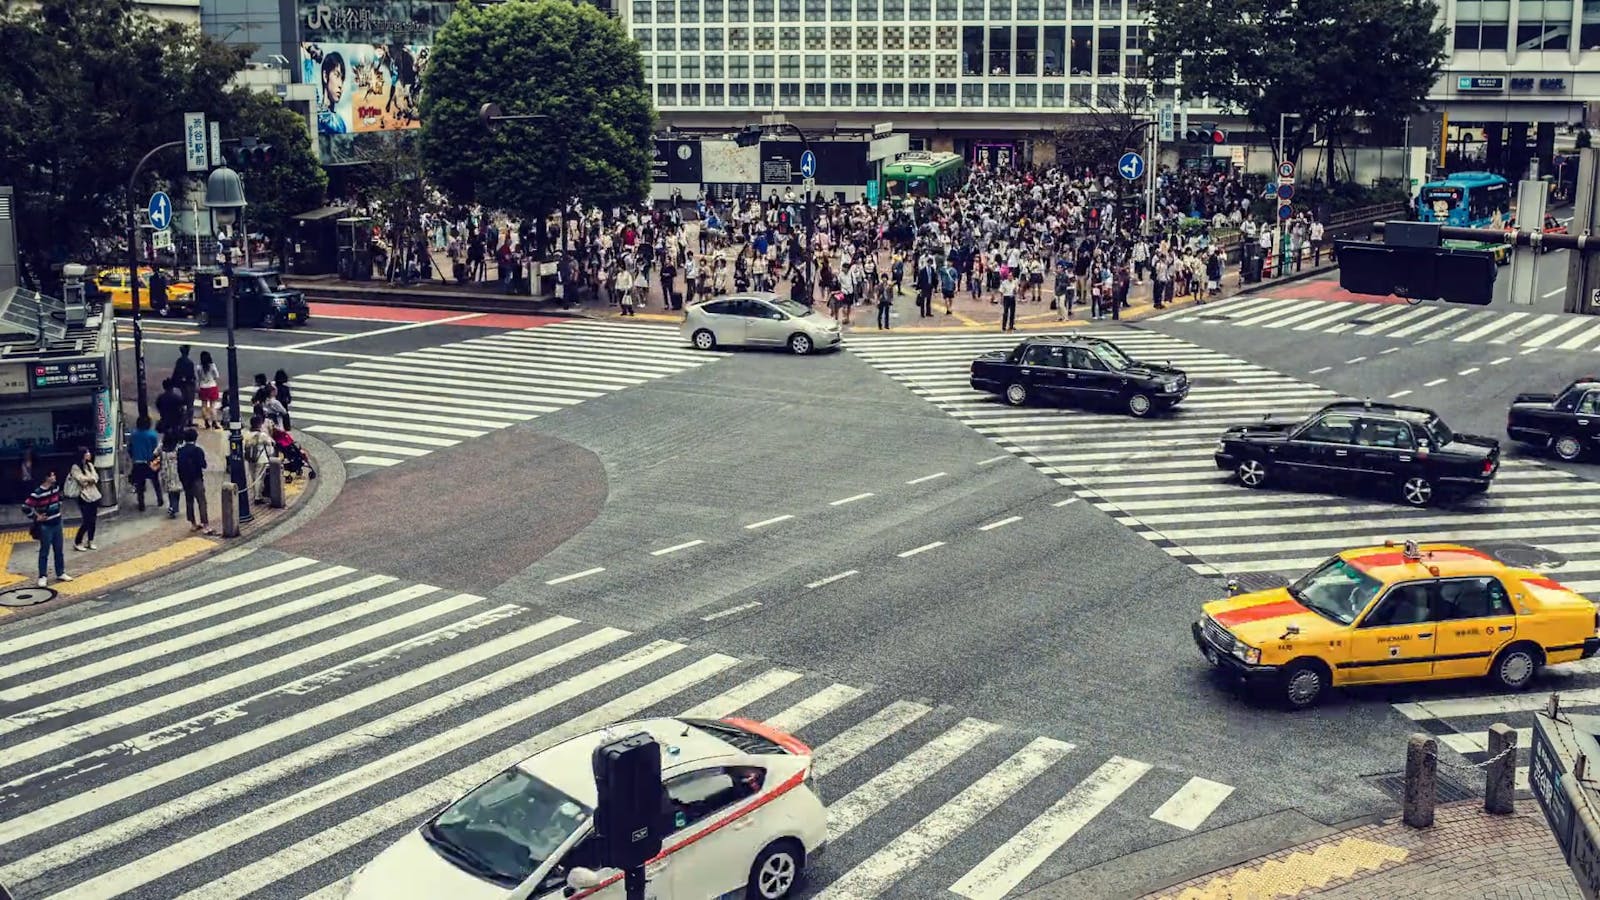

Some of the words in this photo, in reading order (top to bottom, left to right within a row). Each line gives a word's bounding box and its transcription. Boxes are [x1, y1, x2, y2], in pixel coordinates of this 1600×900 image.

[308, 5, 331, 31] JR
[334, 8, 372, 31] 渋谷駅
